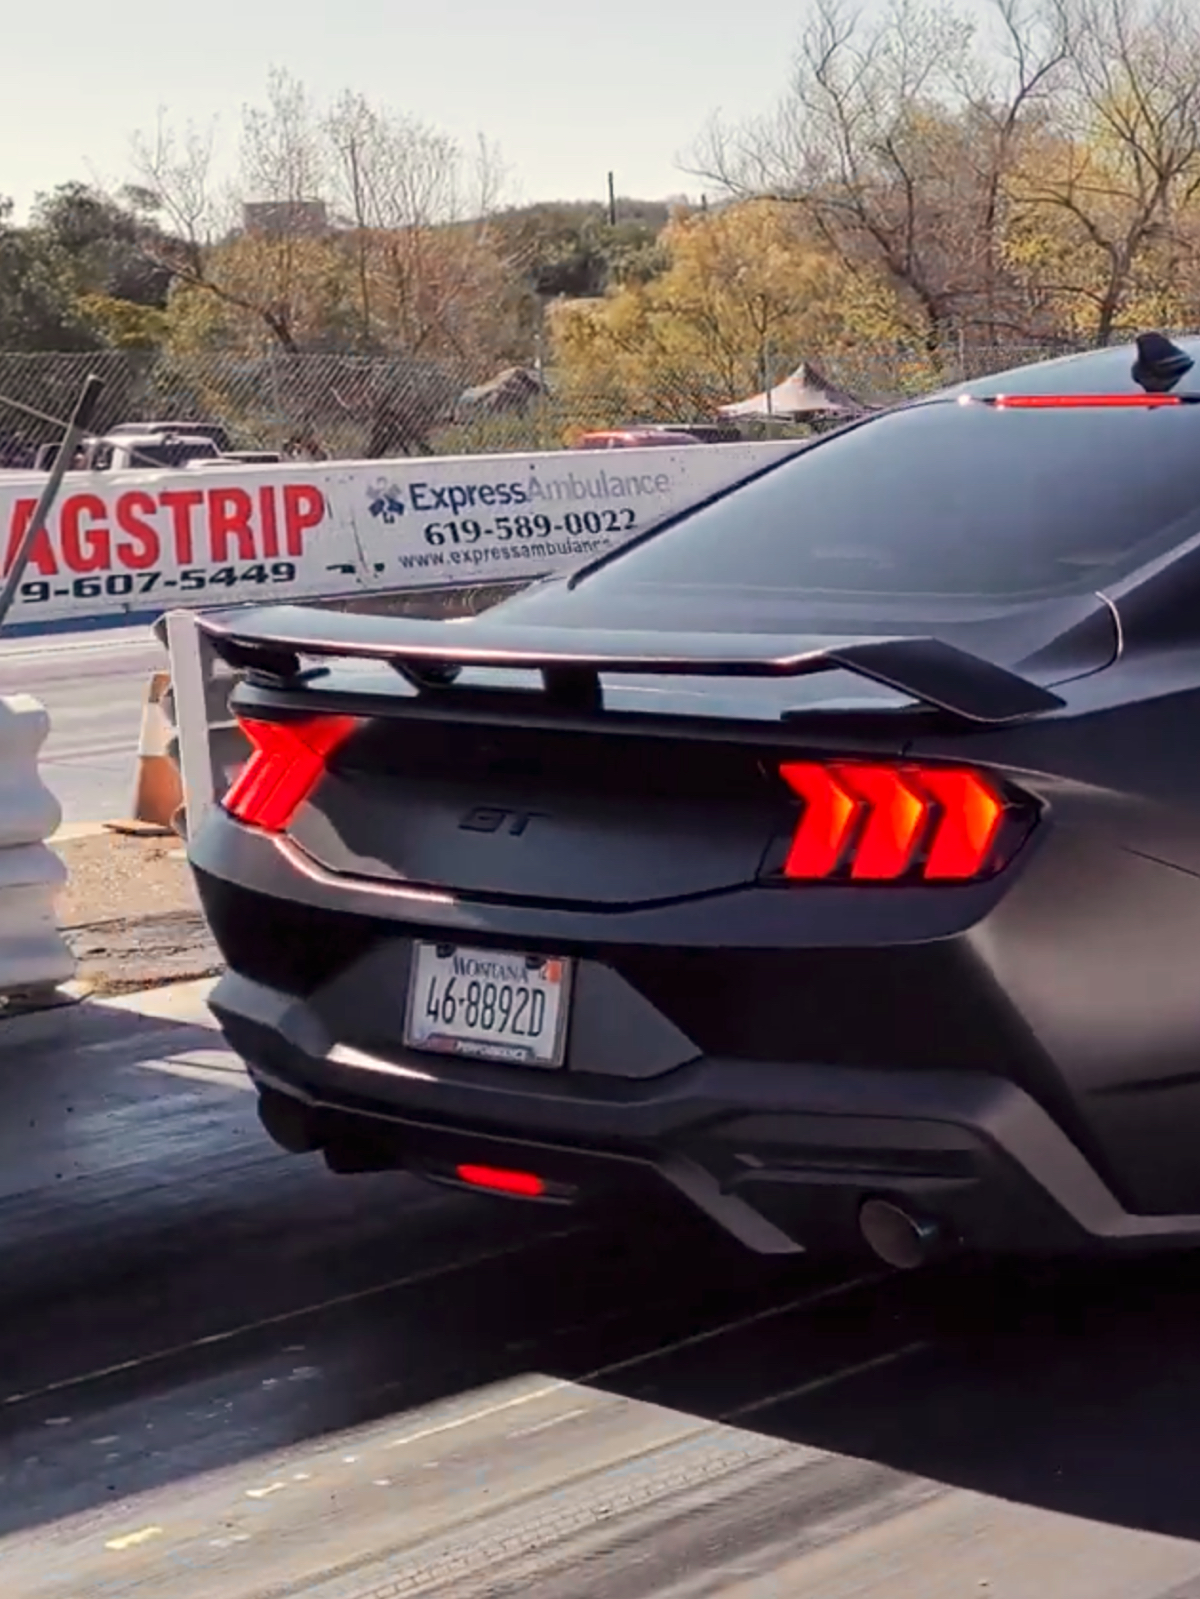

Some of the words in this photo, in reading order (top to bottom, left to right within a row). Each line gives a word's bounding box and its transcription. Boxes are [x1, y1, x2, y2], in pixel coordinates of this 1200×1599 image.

[424, 508, 638, 546] 619-589-0022
[457, 806, 553, 837] GT
[453, 956, 529, 983] MONTANA
